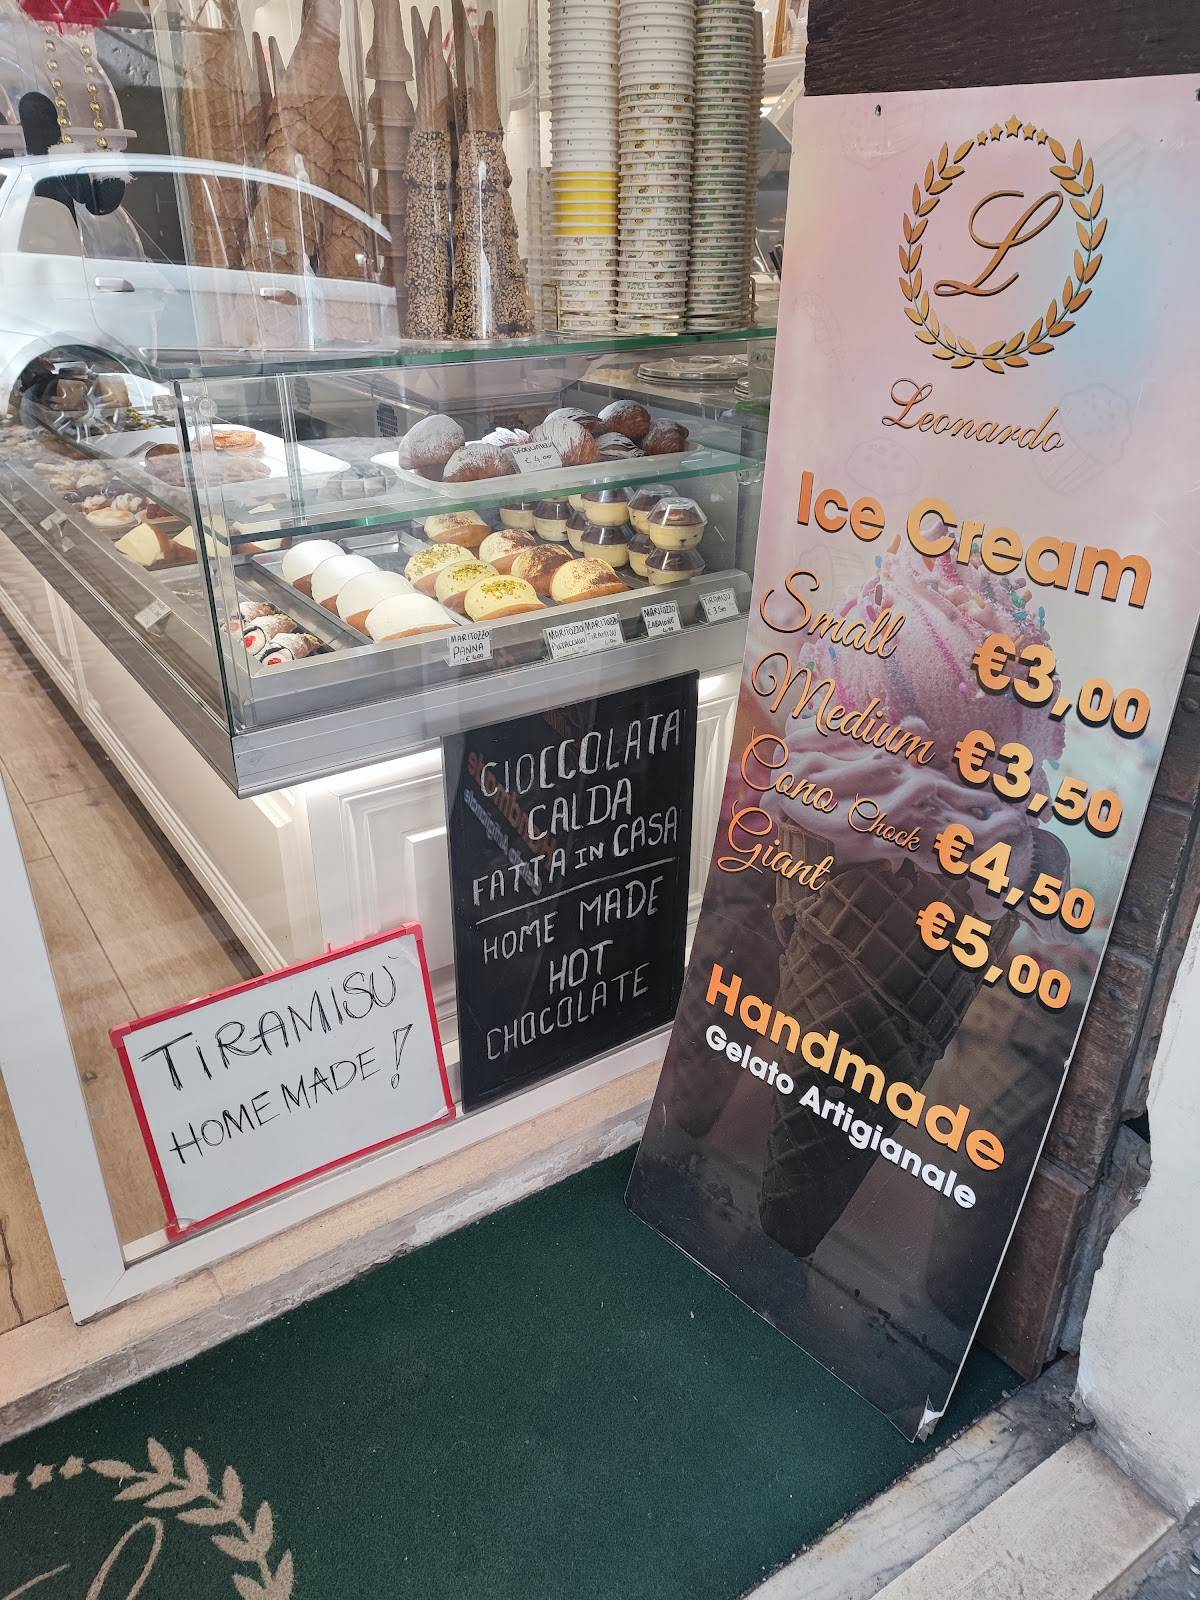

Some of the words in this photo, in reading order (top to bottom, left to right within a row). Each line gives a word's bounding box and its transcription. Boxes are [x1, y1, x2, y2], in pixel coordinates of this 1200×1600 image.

[933, 189, 1065, 297] L
[880, 377, 1066, 454] Leonardo
[796, 470, 886, 543] Ice
[906, 497, 1153, 610] Cream
[450, 630, 490, 643] MARITOZZO
[453, 642, 484, 660] PANNA
[758, 567, 907, 660] Small
[972, 632, 1153, 739] €3,00
[479, 708, 682, 797] CIOCCOLATA
[751, 651, 937, 767] Medium
[952, 729, 1124, 839] €3,50
[472, 848, 567, 906] FATTA
[574, 841, 604, 870] IN
[613, 805, 679, 859] CASA
[526, 777, 633, 842] CALDA
[740, 726, 839, 815] Cono
[847, 792, 922, 853] Chock
[933, 822, 1097, 934] €4,50
[483, 911, 559, 965] HOME
[579, 875, 664, 932] MADE
[716, 799, 836, 893] Giant
[916, 900, 1073, 1013] €5,00
[486, 962, 651, 1061] CHOCOLATE
[548, 939, 614, 994] HOT
[705, 962, 1006, 1173] Handmade
[705, 1024, 796, 1096] Gelato
[799, 1084, 977, 1210] Artigianale
